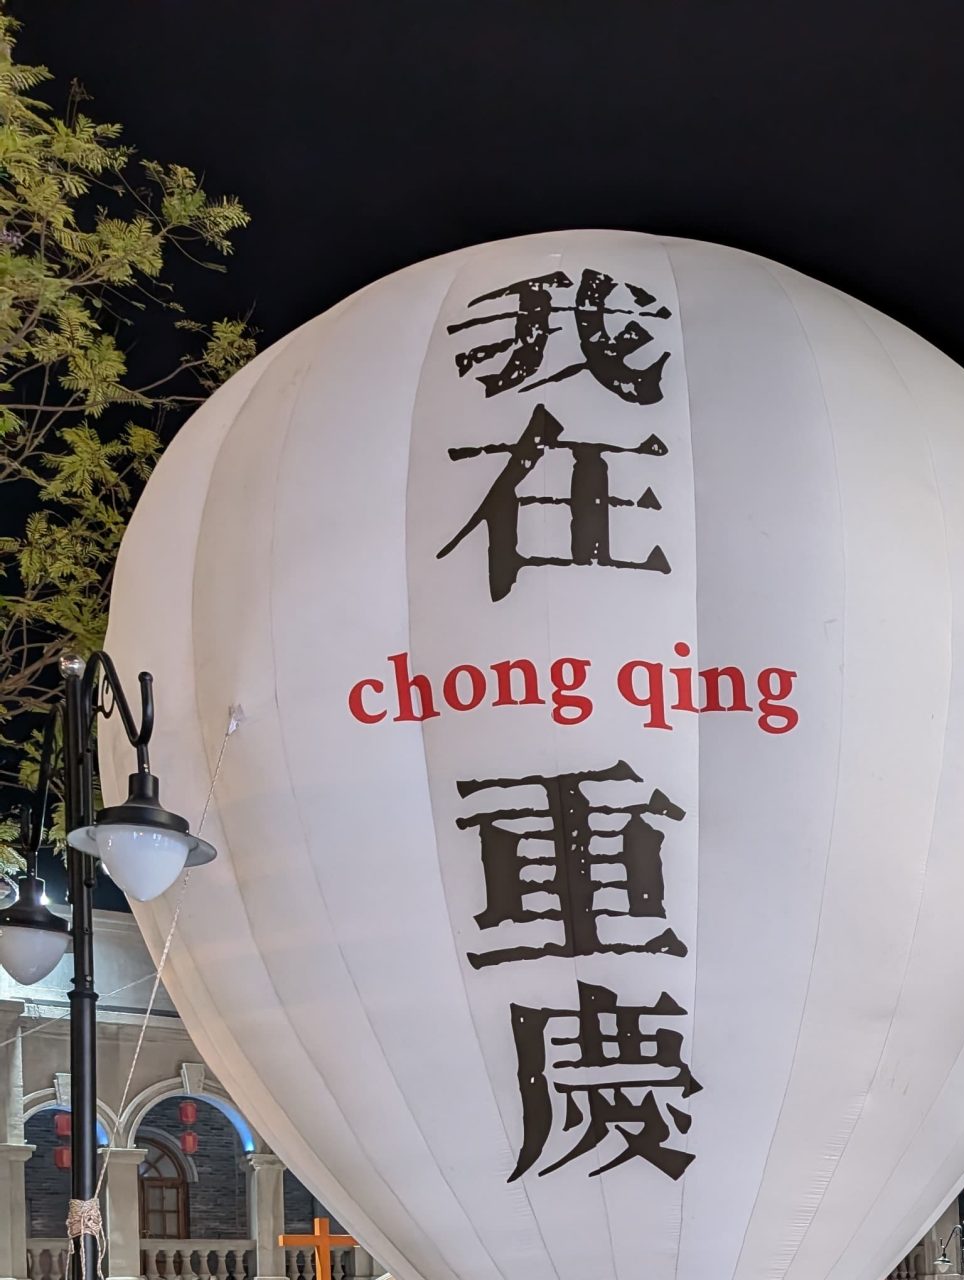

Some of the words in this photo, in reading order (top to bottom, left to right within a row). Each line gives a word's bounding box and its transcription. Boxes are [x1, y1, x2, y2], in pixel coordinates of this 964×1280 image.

[437, 269, 671, 602] 我在
[348, 651, 593, 725] chong
[617, 642, 800, 735] qing
[456, 760, 704, 1183] 重慶
